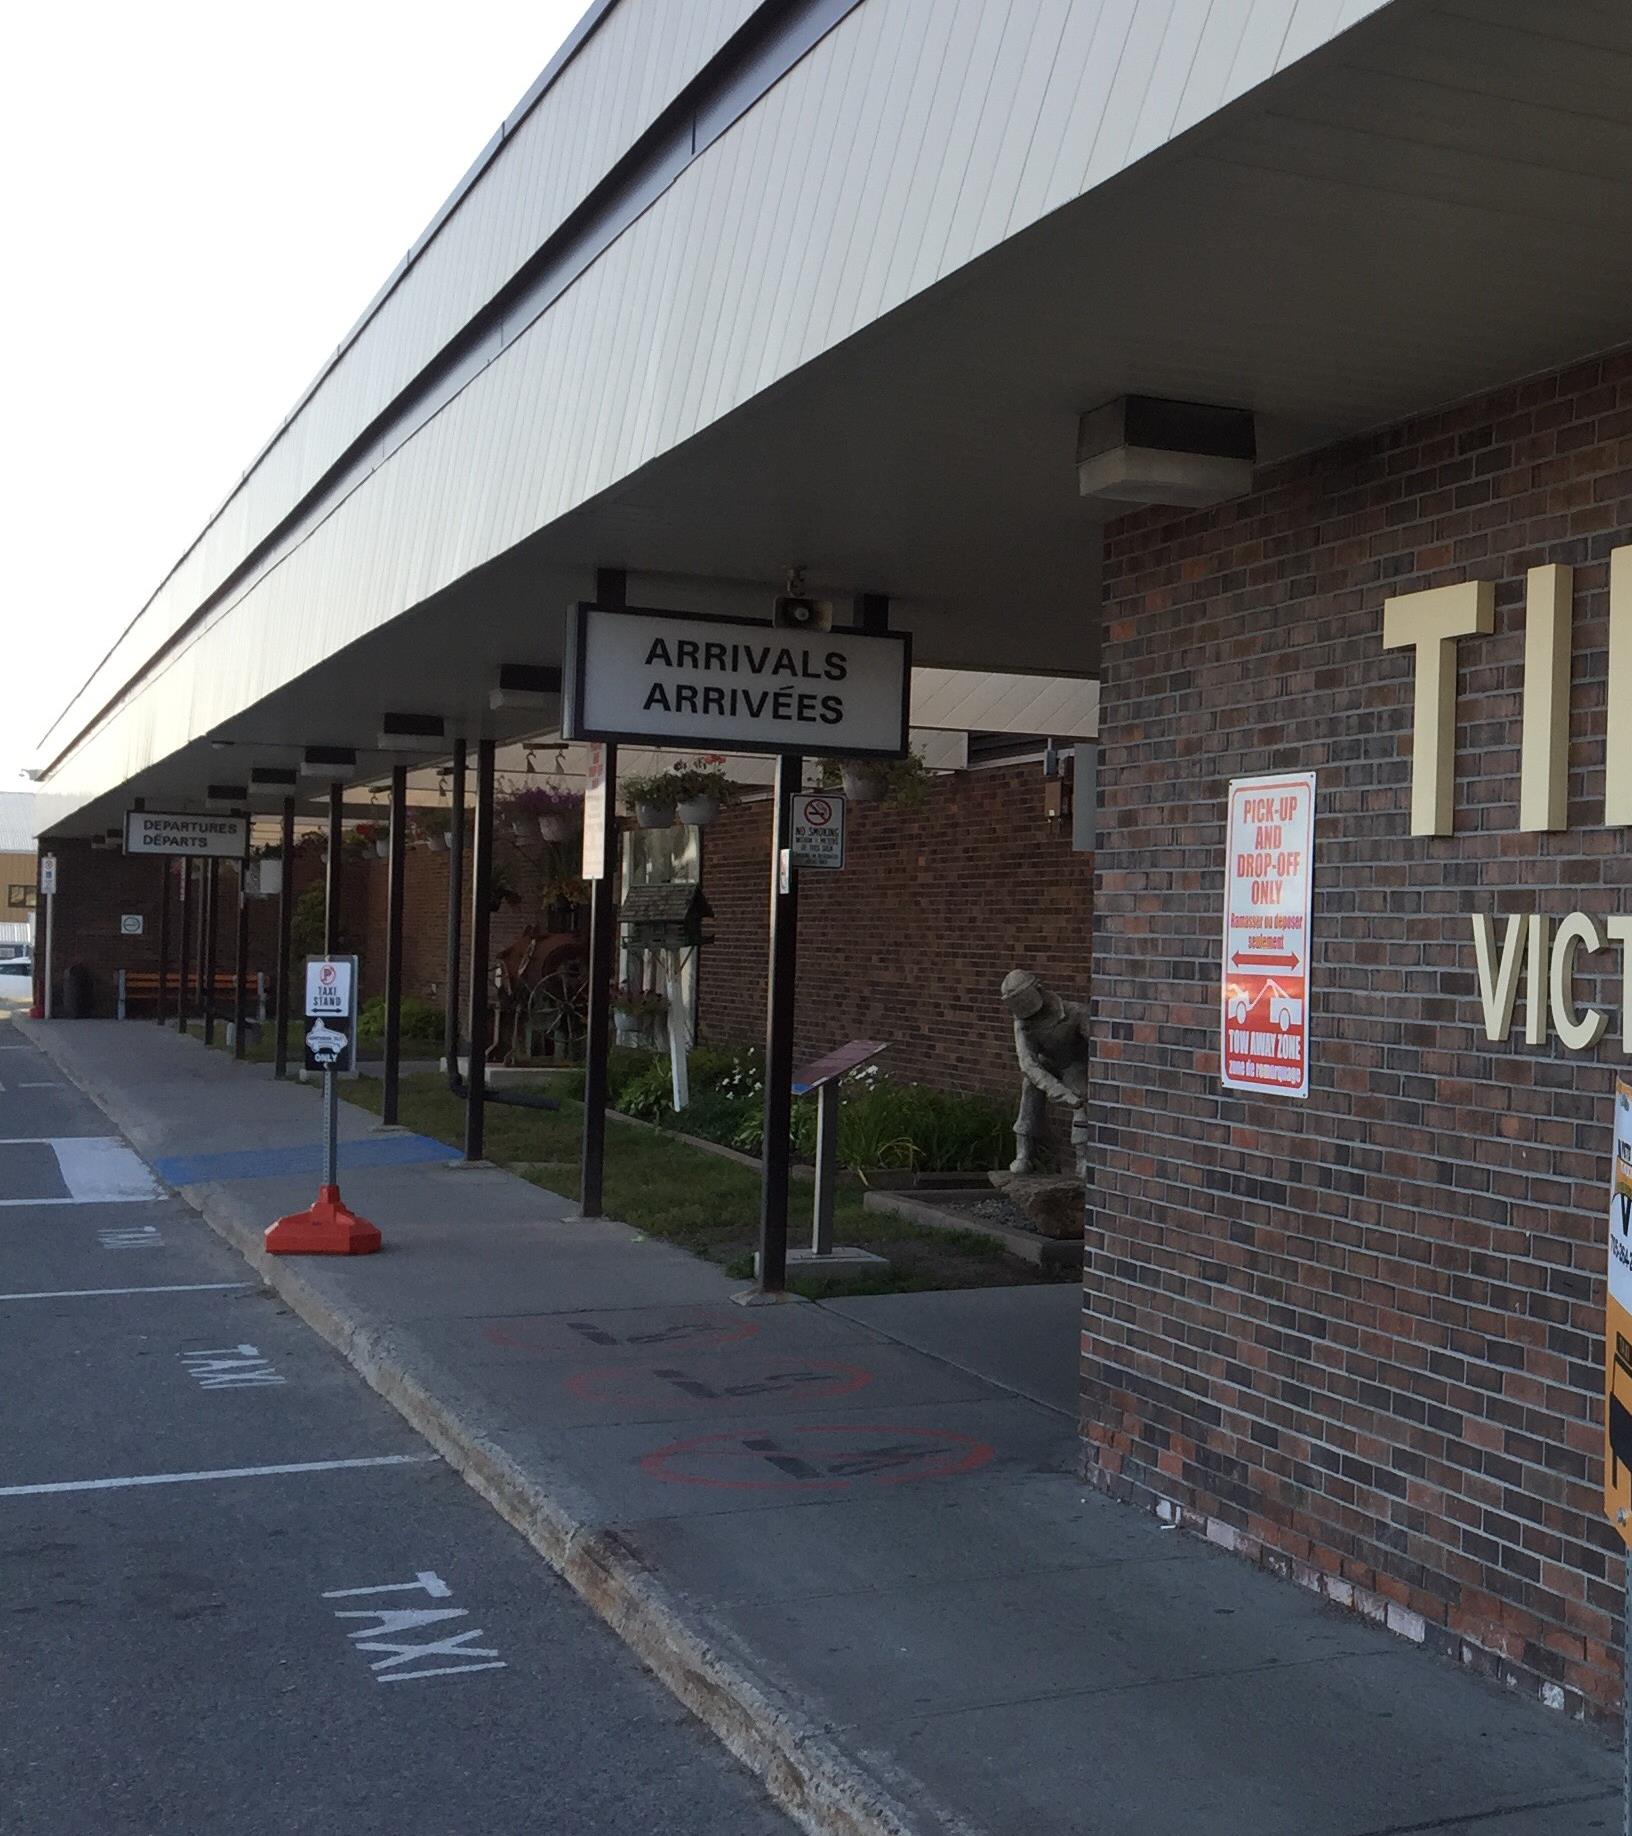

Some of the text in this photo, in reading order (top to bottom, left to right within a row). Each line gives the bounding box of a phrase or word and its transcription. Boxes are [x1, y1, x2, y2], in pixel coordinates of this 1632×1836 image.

[644, 637, 848, 682] ARRIVALS
[643, 683, 844, 725] ARRIVÉES
[1243, 796, 1298, 825] PICK-UP
[143, 819, 238, 835] DEPARTURES
[1255, 825, 1282, 850] AND
[143, 833, 208, 848] DÉPARTS
[1236, 851, 1301, 878] DROP-OFF
[1251, 880, 1283, 905] ONLY
[313, 997, 342, 1007] STAND
[318, 986, 337, 997] TAXI
[314, 1051, 338, 1062] ONLY
[1228, 1029, 1301, 1061] TOW AWAY ZONE
[180, 1343, 289, 1390] TAXI
[321, 1570, 508, 1682] TAXI
